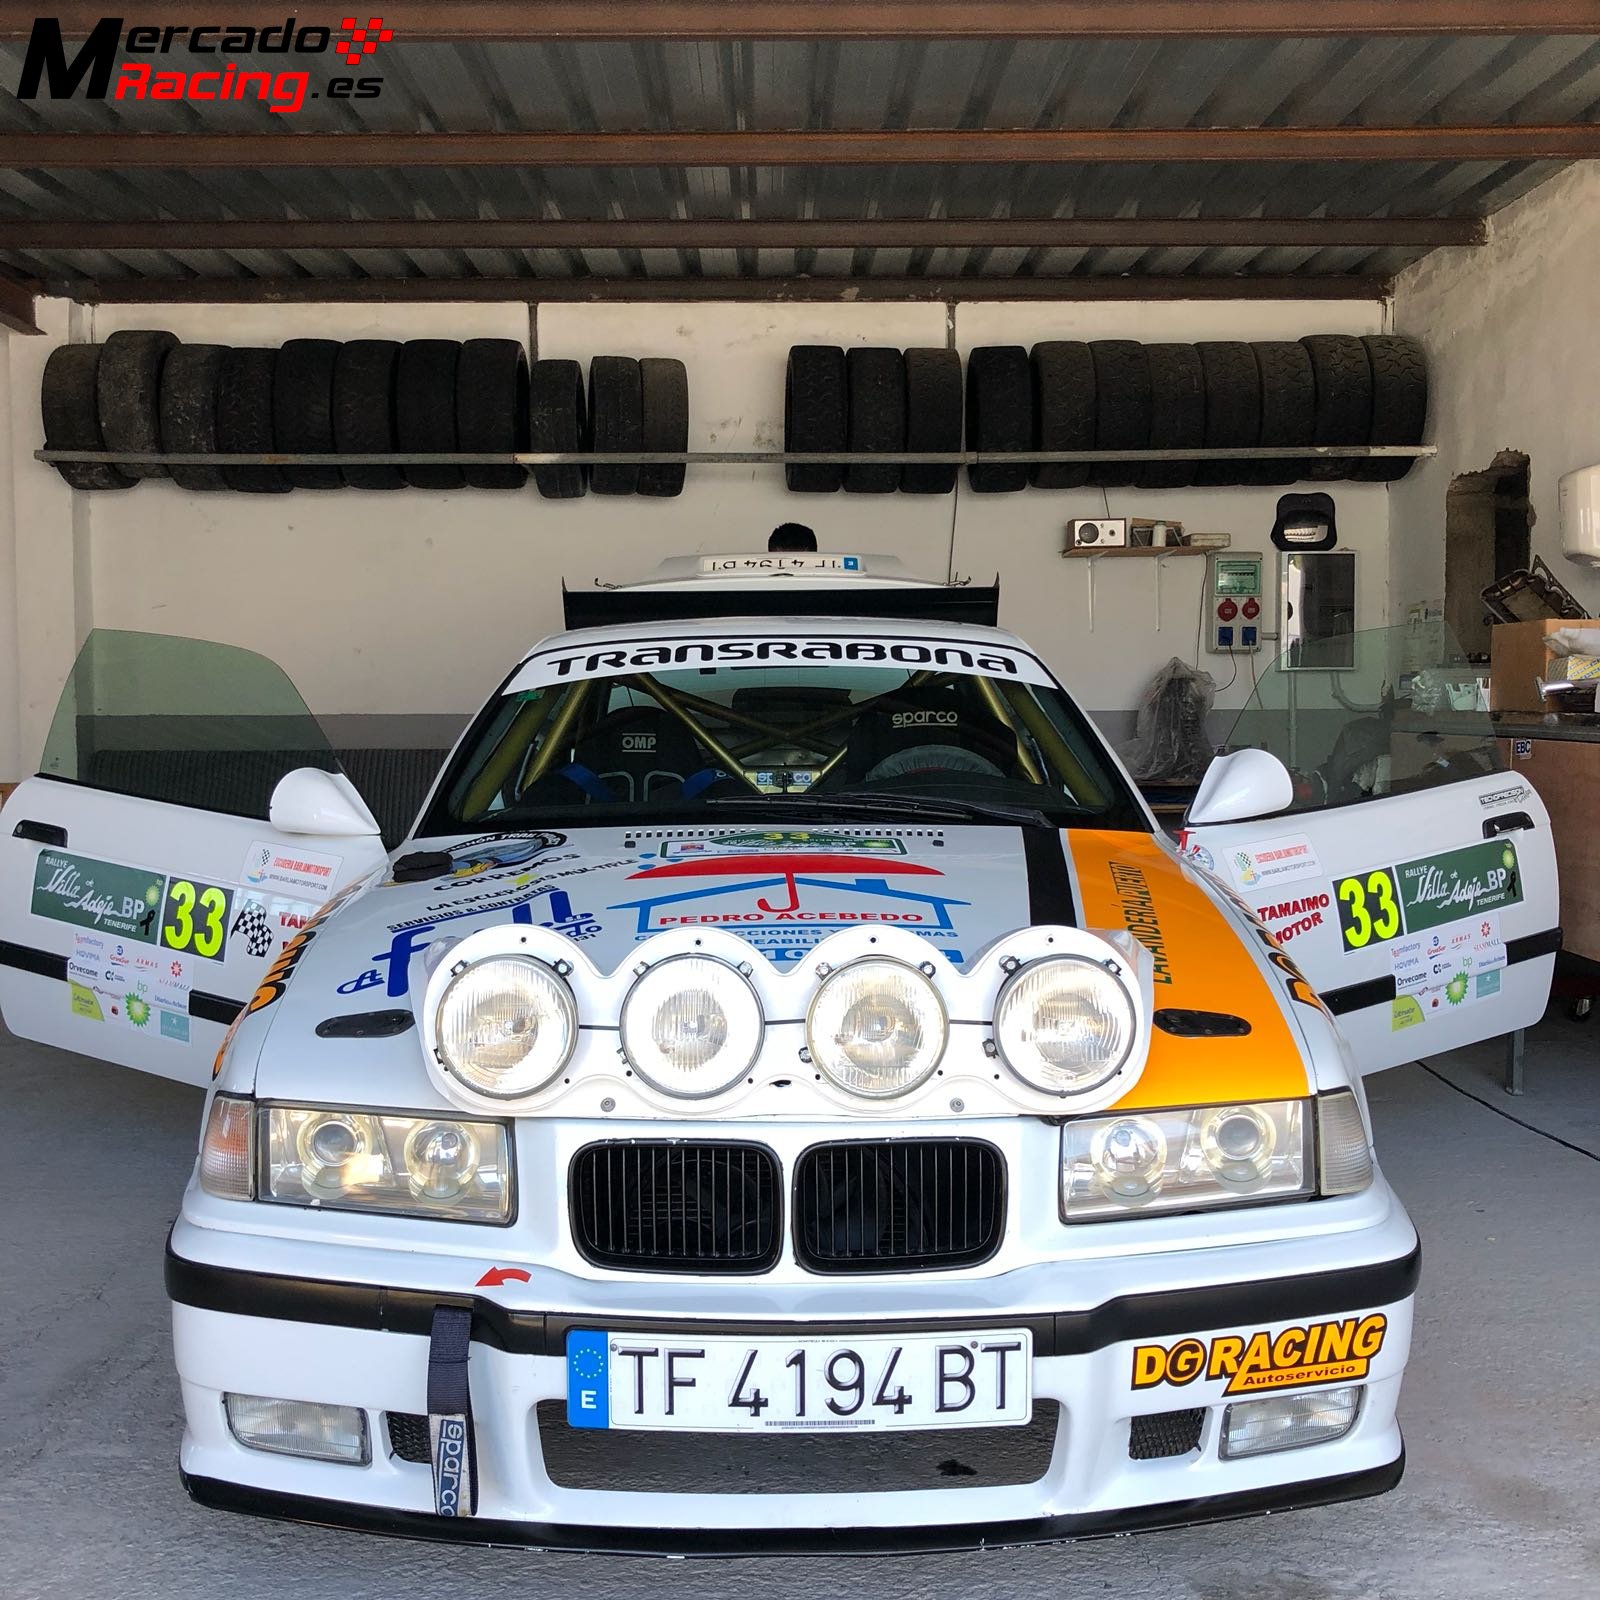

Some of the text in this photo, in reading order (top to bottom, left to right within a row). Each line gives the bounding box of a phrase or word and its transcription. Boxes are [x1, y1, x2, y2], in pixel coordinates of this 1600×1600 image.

[892, 710, 958, 728] sparco
[622, 736, 657, 749] OMP
[1516, 740, 1531, 754] EBC
[45, 856, 68, 869] RALLYE
[434, 854, 580, 891] CORREMOS
[1405, 865, 1428, 878] RALLYE
[36, 864, 80, 898] Villa
[450, 874, 557, 905] ESCLEROSIS
[1406, 865, 1450, 907] Villa
[1487, 867, 1506, 890] BP
[121, 896, 145, 919] BP
[1257, 894, 1329, 922] TAMAIMO
[1339, 871, 1399, 947] 33
[1476, 893, 1506, 906] TENERIFE
[103, 918, 137, 933] TENERIFE
[165, 881, 226, 957] 33
[387, 909, 463, 931] SERVICIOS
[660, 912, 923, 925] PEDRO ACEBEDO
[1273, 912, 1324, 945] MOTOR
[69, 962, 98, 977] Orvecame
[1462, 956, 1472, 968] bp
[1397, 972, 1427, 986] Orvecame
[618, 1340, 1022, 1418] TF 4194 BT
[1243, 1364, 1356, 1386] Autoservicio
[582, 1390, 596, 1410] E
[440, 1423, 463, 1517] sparco
